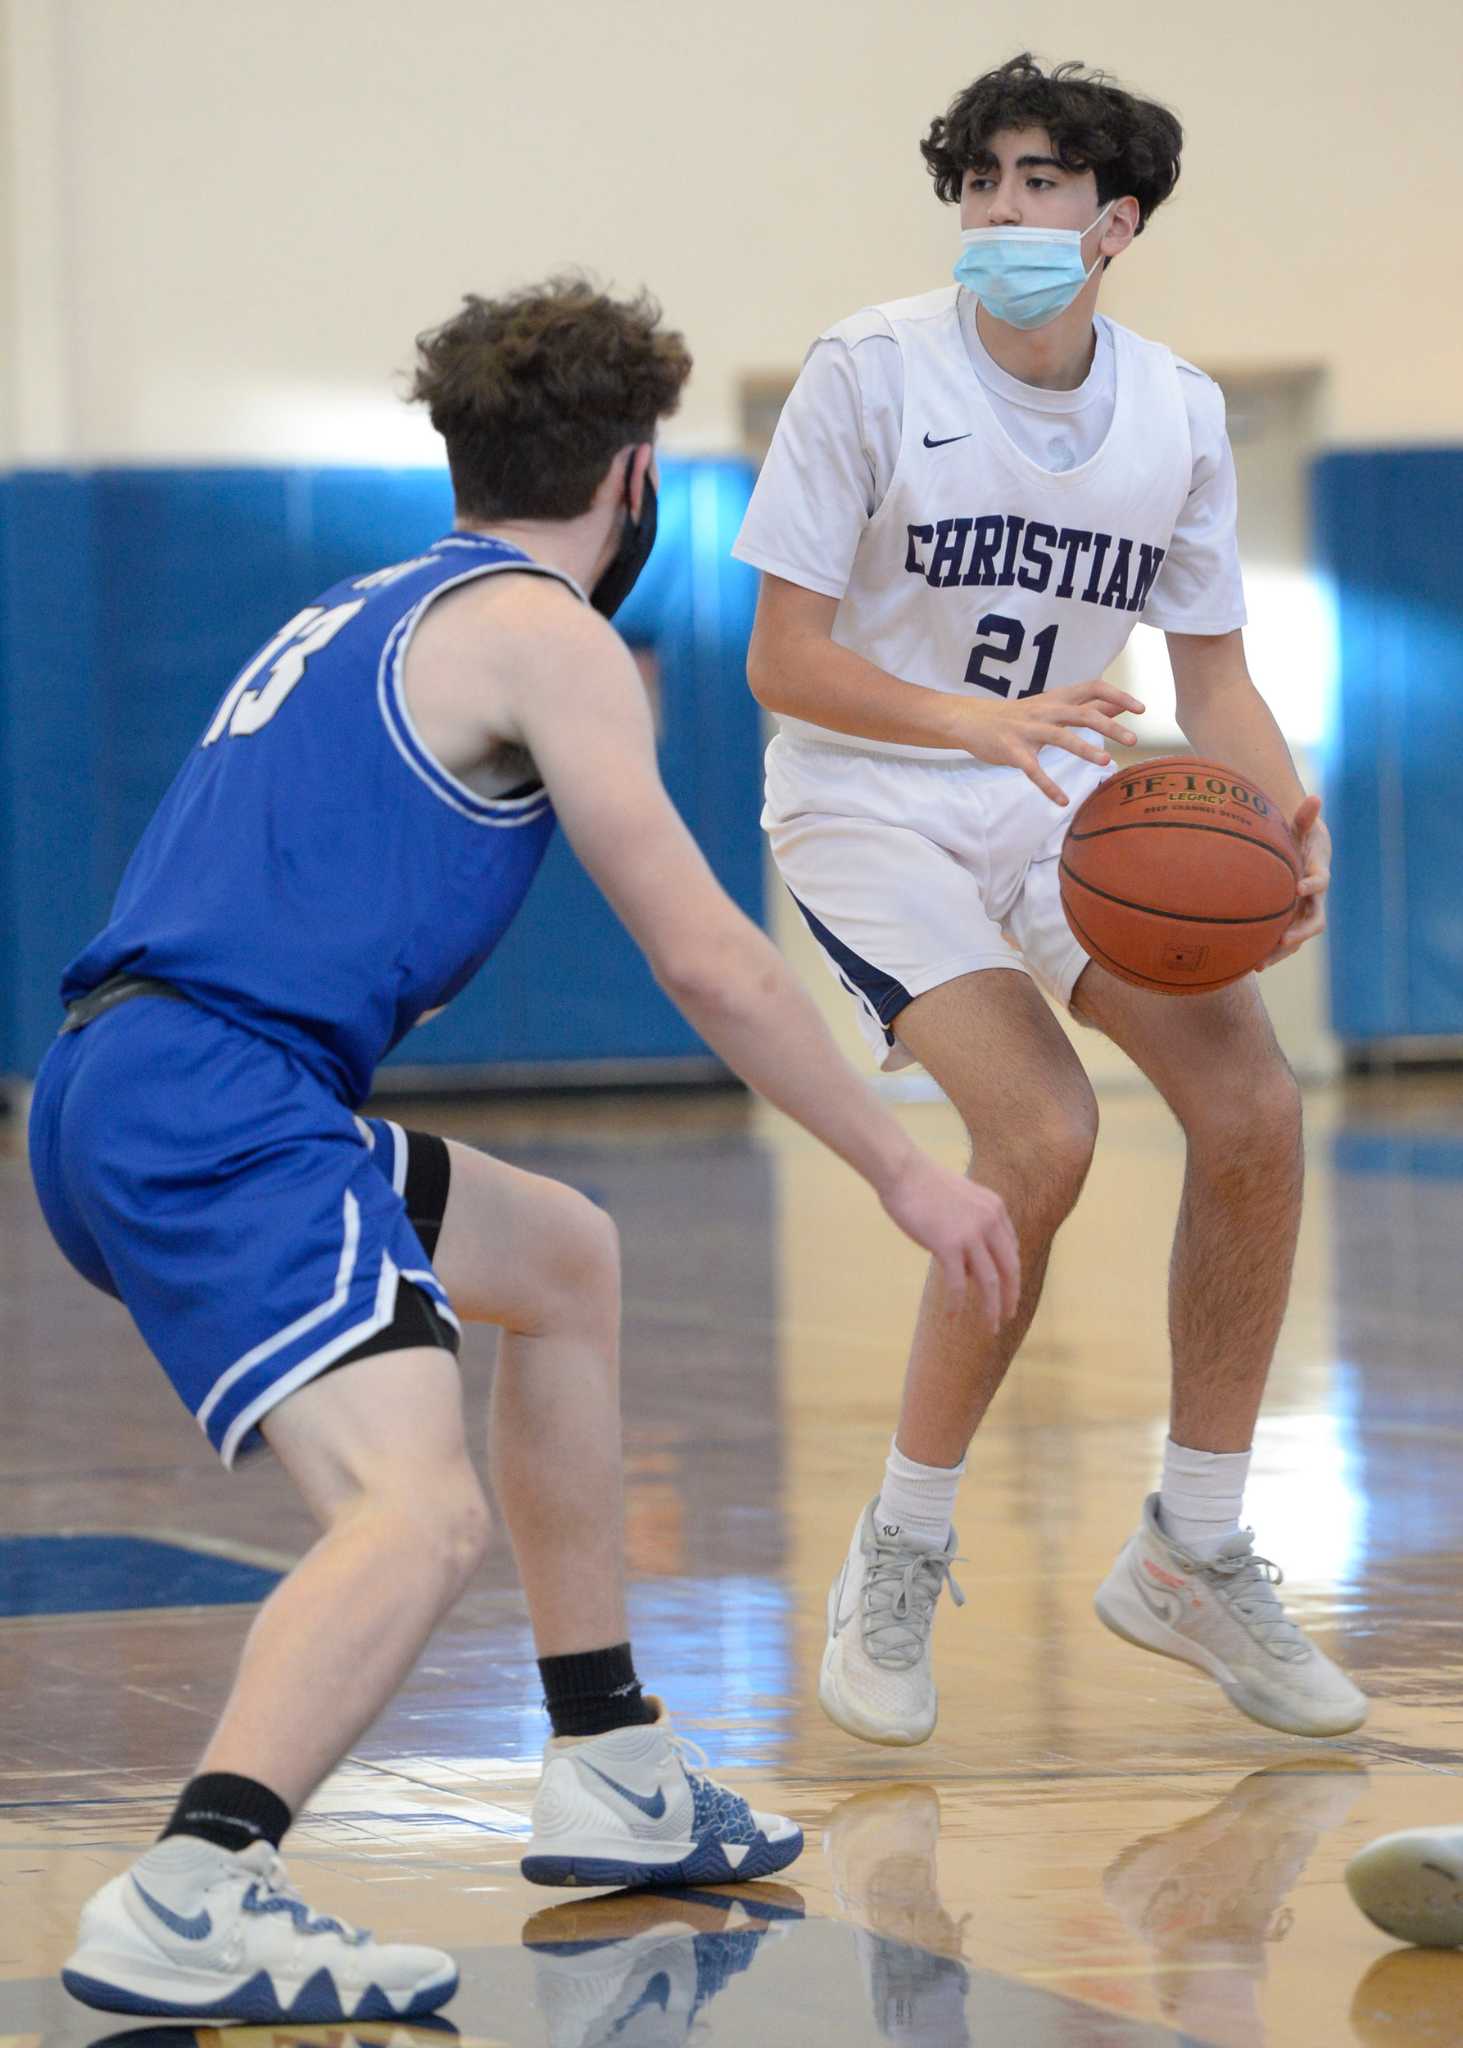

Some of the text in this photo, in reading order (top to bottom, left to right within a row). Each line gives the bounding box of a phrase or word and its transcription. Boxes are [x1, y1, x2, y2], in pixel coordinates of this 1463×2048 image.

[905, 514, 1165, 612] CHRISTIAN
[201, 597, 368, 748] 13
[963, 612, 1059, 700] 21
[1119, 774, 1270, 817] TF-1000
[1167, 792, 1228, 805] LEGACY
